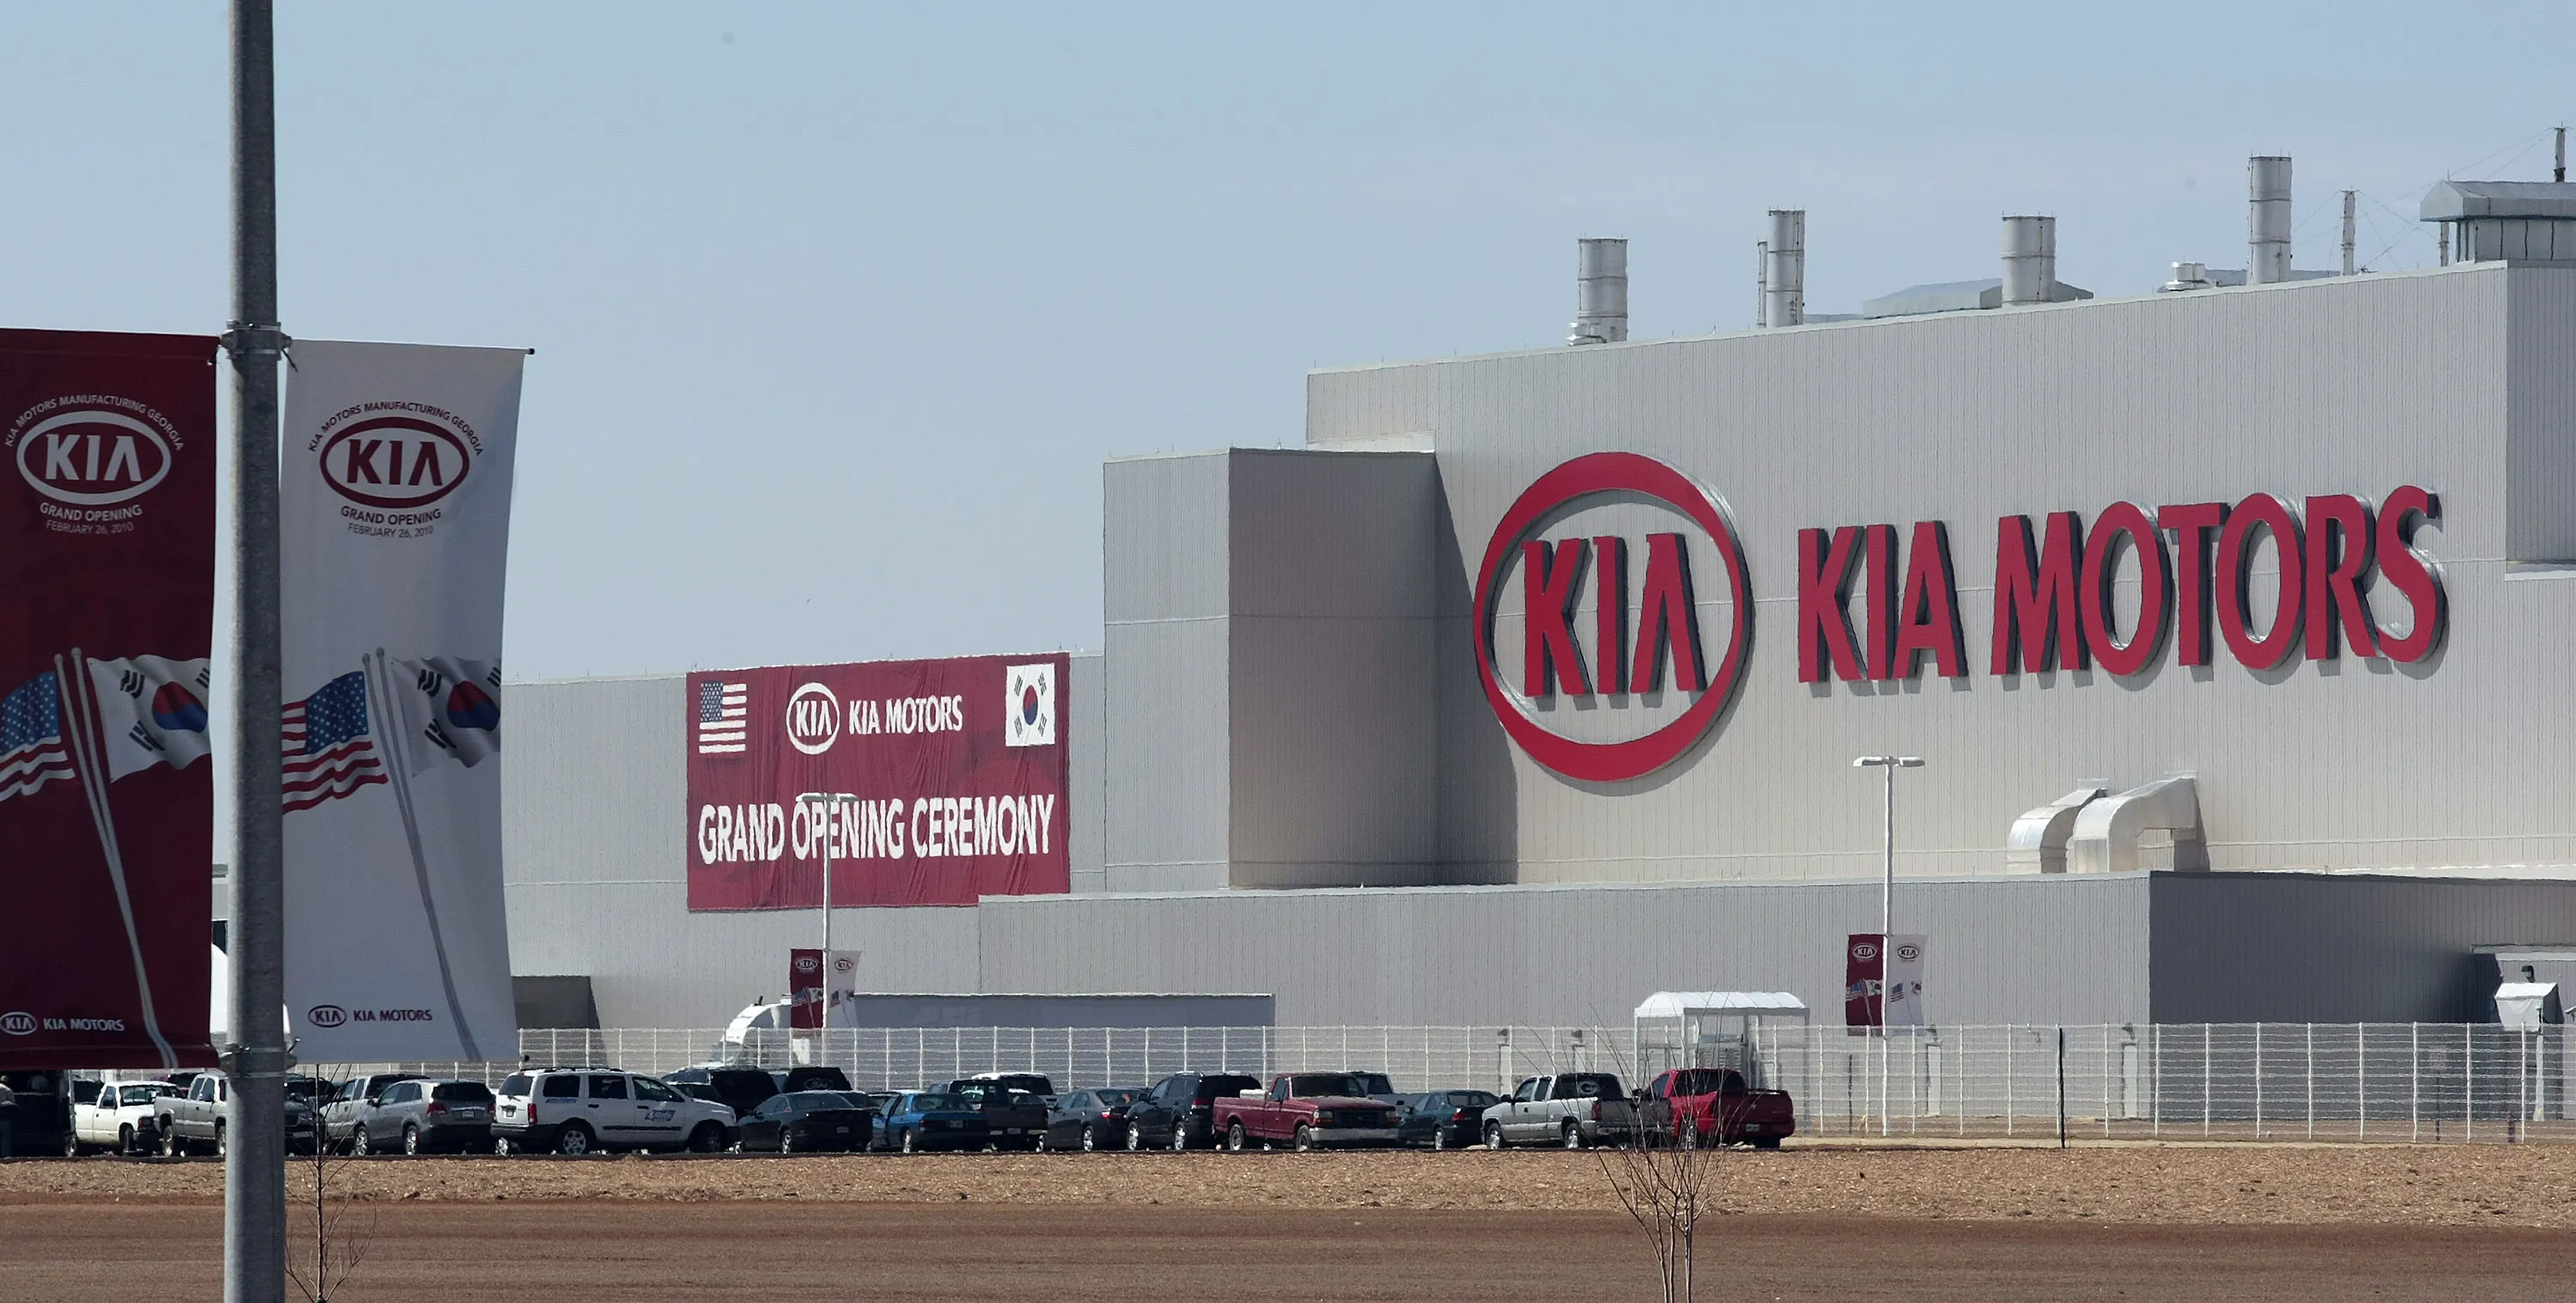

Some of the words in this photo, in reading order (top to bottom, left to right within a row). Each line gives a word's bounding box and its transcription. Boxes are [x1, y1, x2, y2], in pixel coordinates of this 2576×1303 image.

[4, 428, 18, 448] KIA
[15, 399, 57, 428] MOTORS
[59, 394, 146, 414] MANUFACTURING
[147, 408, 184, 451] GEORGIA
[307, 433, 323, 452] KIA
[321, 405, 361, 433] MOTORS
[364, 401, 450, 421] MANUFACTURING
[451, 416, 483, 457] GEORGIA
[46, 433, 142, 482] KIA
[347, 439, 443, 486] KIA
[39, 502, 82, 521] GRAND
[85, 504, 143, 521] OPENING
[46, 520, 93, 533] FEBRUARY
[111, 521, 134, 533] 2010
[341, 505, 384, 524] GRAND
[388, 508, 441, 525] OPENING
[348, 523, 396, 537] FEBRUARY
[415, 526, 434, 537] 2010
[1797, 520, 1968, 684] KIA
[1990, 484, 2448, 676] MOTORS
[1521, 532, 1707, 699] KIA
[795, 700, 833, 737] KIA
[848, 700, 881, 734] KIA
[885, 695, 963, 734] MOTORS
[698, 803, 785, 865] GRAND
[792, 798, 904, 860] OPENING
[912, 794, 1054, 858] CEREMONY
[4, 1017, 33, 1030] KIA
[43, 1019, 67, 1030] KIA
[70, 1019, 125, 1031] MOTORS
[315, 1011, 341, 1023] KIA
[353, 1010, 376, 1021] KIA
[380, 1009, 433, 1021] MOTORS
